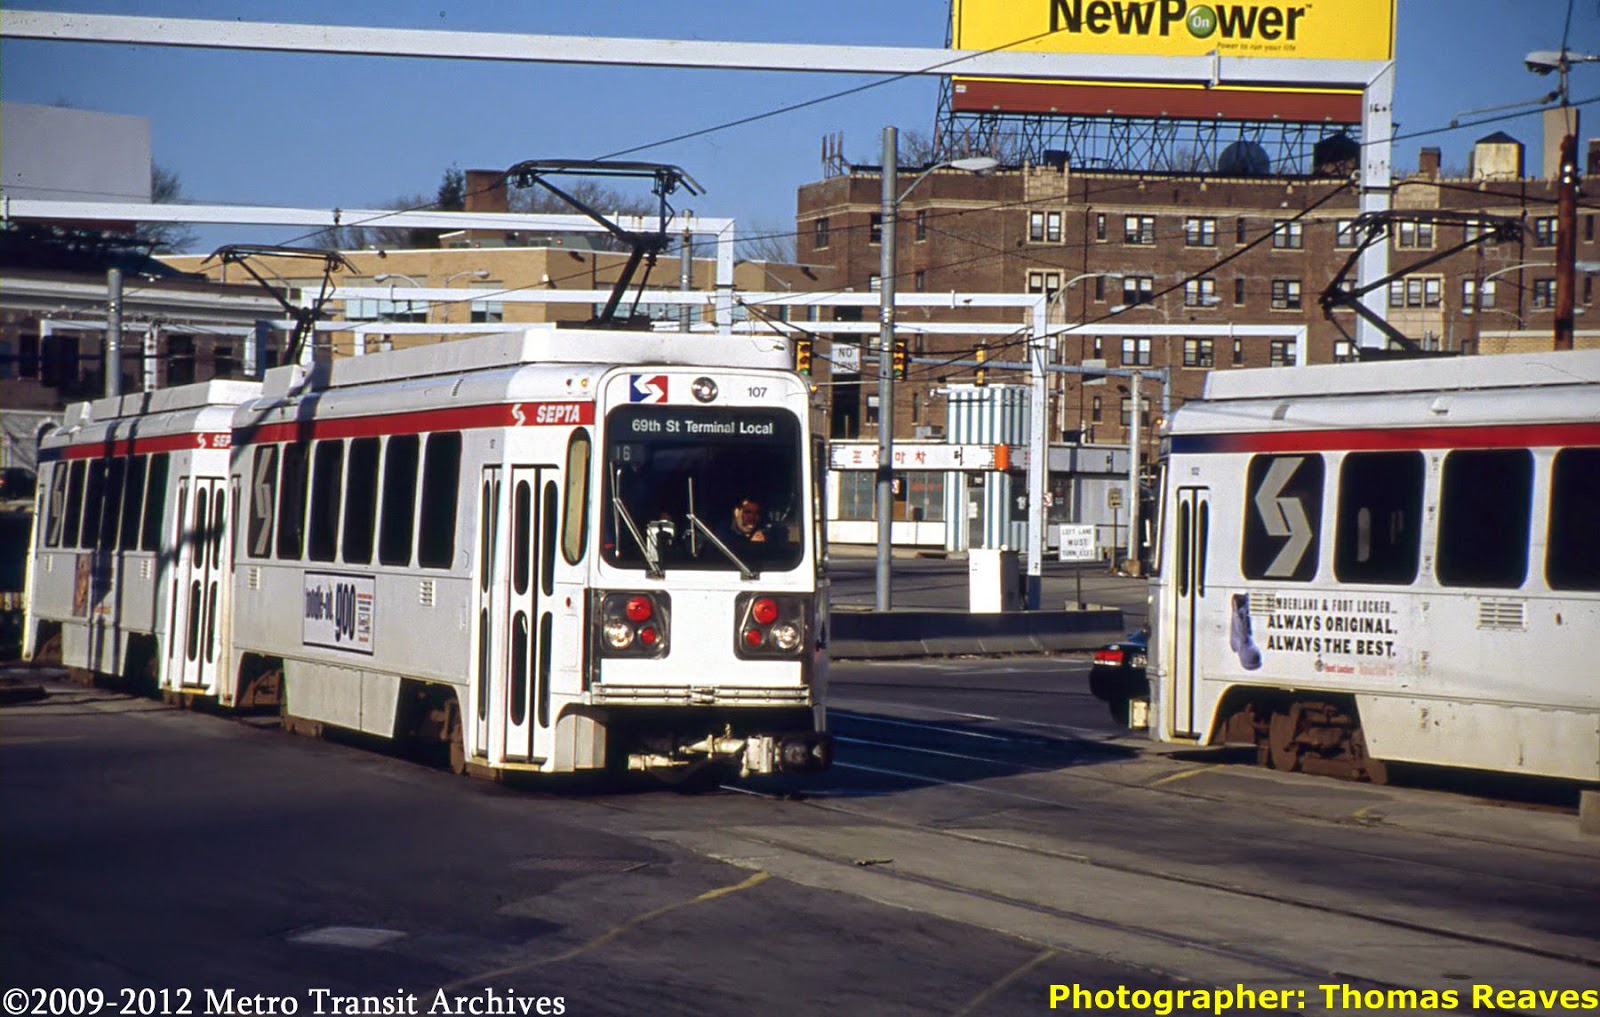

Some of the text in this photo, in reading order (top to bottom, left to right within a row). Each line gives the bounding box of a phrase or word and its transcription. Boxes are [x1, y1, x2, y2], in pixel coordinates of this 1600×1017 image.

[1191, 16, 1210, 28] On
[1217, 42, 1239, 50] Power
[1284, 44, 1297, 52] life
[838, 347, 853, 358] NO
[747, 387, 768, 398] 107
[536, 404, 581, 424] SEPTA
[632, 419, 773, 435] 69th St Terminal Local
[212, 434, 232, 448] SEP
[1332, 599, 1353, 612] FOOT
[1267, 614, 1398, 634] ALWAYS ORIGINAL.
[1267, 635, 1397, 657] ALWAYS THE BEST.
